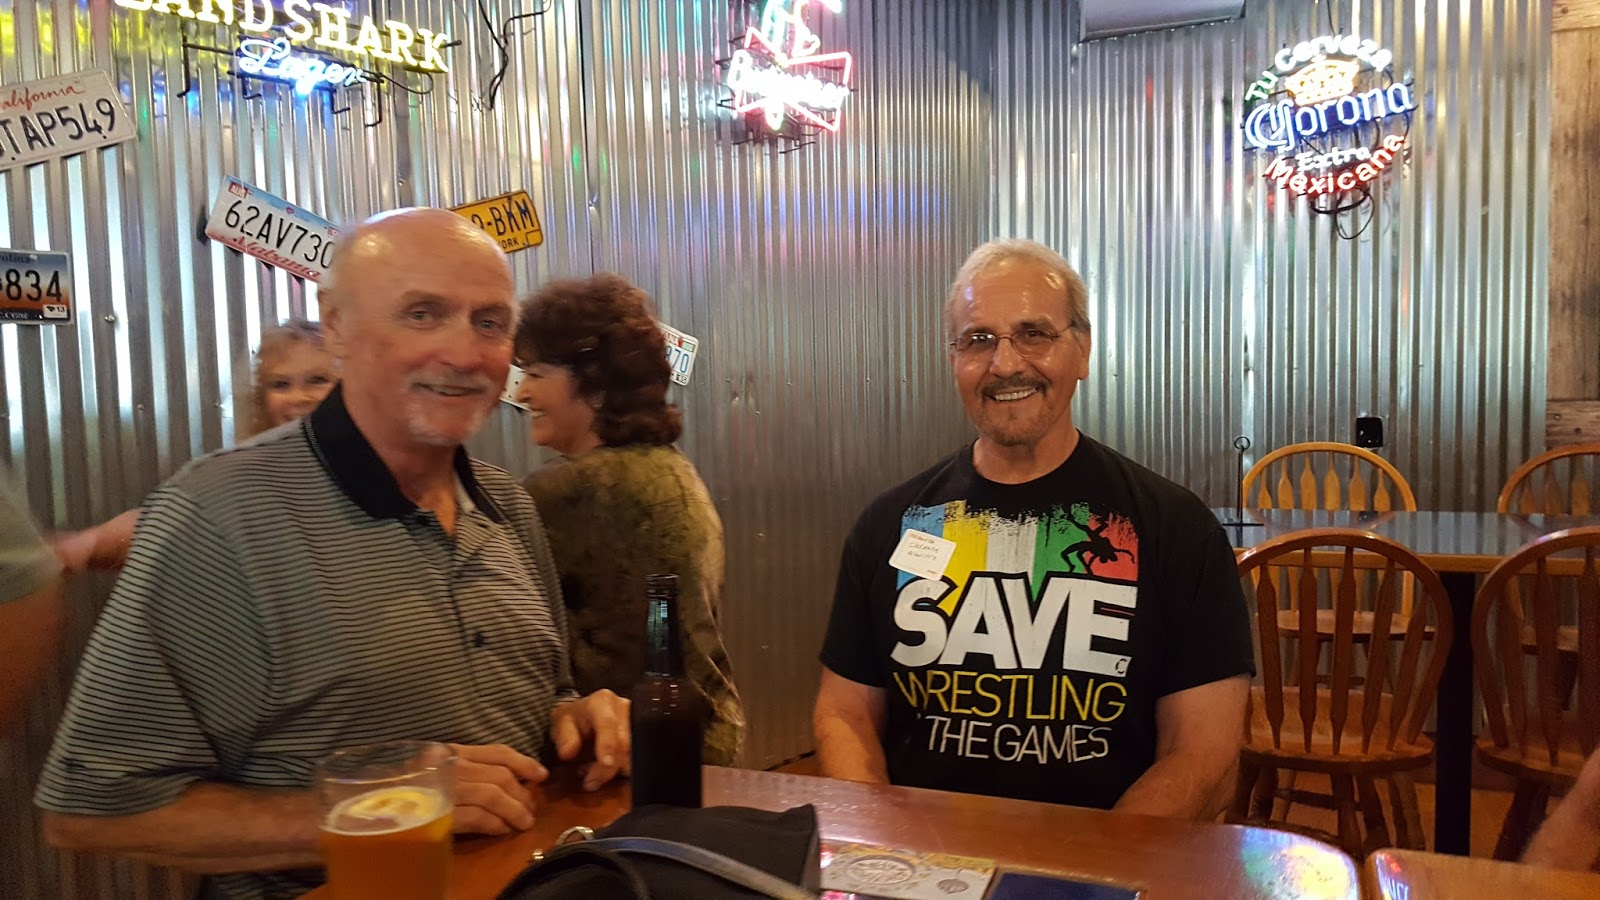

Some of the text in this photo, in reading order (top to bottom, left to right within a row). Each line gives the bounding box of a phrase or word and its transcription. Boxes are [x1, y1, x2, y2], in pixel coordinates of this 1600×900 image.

[283, 0, 450, 73] SHARK
[239, 37, 369, 95] Lager
[0, 84, 87, 111] alifornia
[0, 97, 115, 156] TAP549
[1244, 82, 1414, 152] Corona
[1264, 134, 1405, 194] Mexicana
[1295, 146, 1372, 172] Extra
[890, 575, 1138, 677] SAVE
[893, 670, 1127, 722] WRESTLING
[925, 715, 1112, 764] THE GAMES
